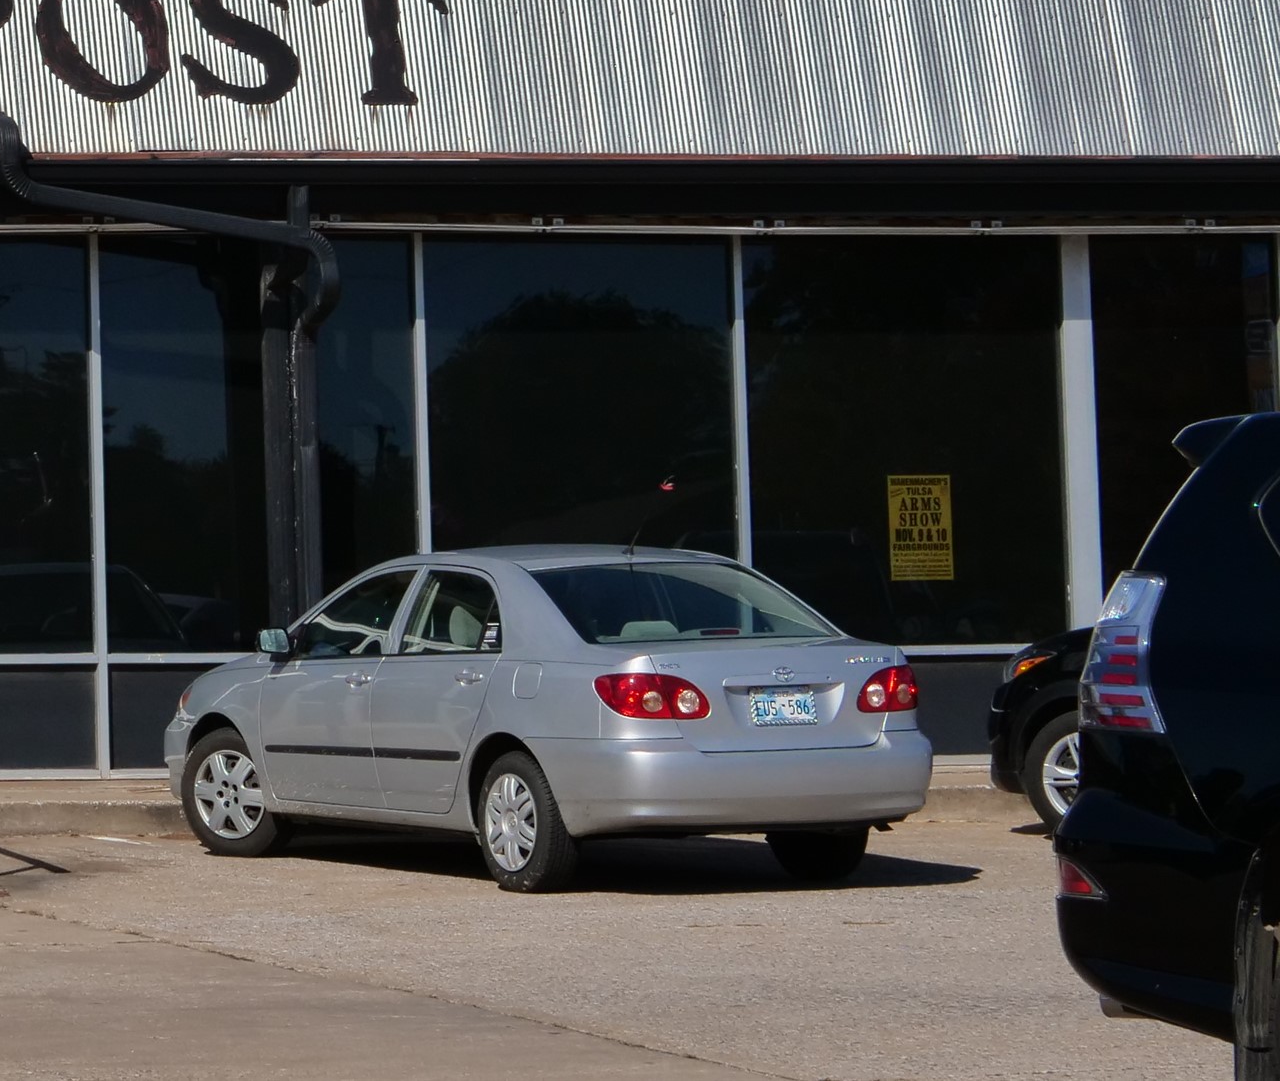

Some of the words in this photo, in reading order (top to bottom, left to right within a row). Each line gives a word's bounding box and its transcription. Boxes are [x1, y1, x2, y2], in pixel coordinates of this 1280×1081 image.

[906, 487, 933, 496] TULSA
[899, 497, 941, 511] ARMS
[899, 512, 942, 527] SHOW
[895, 529, 916, 542] NOV.
[926, 529, 933, 542] &
[936, 528, 947, 542] 10
[893, 543, 950, 551] FAIRGROUNDS
